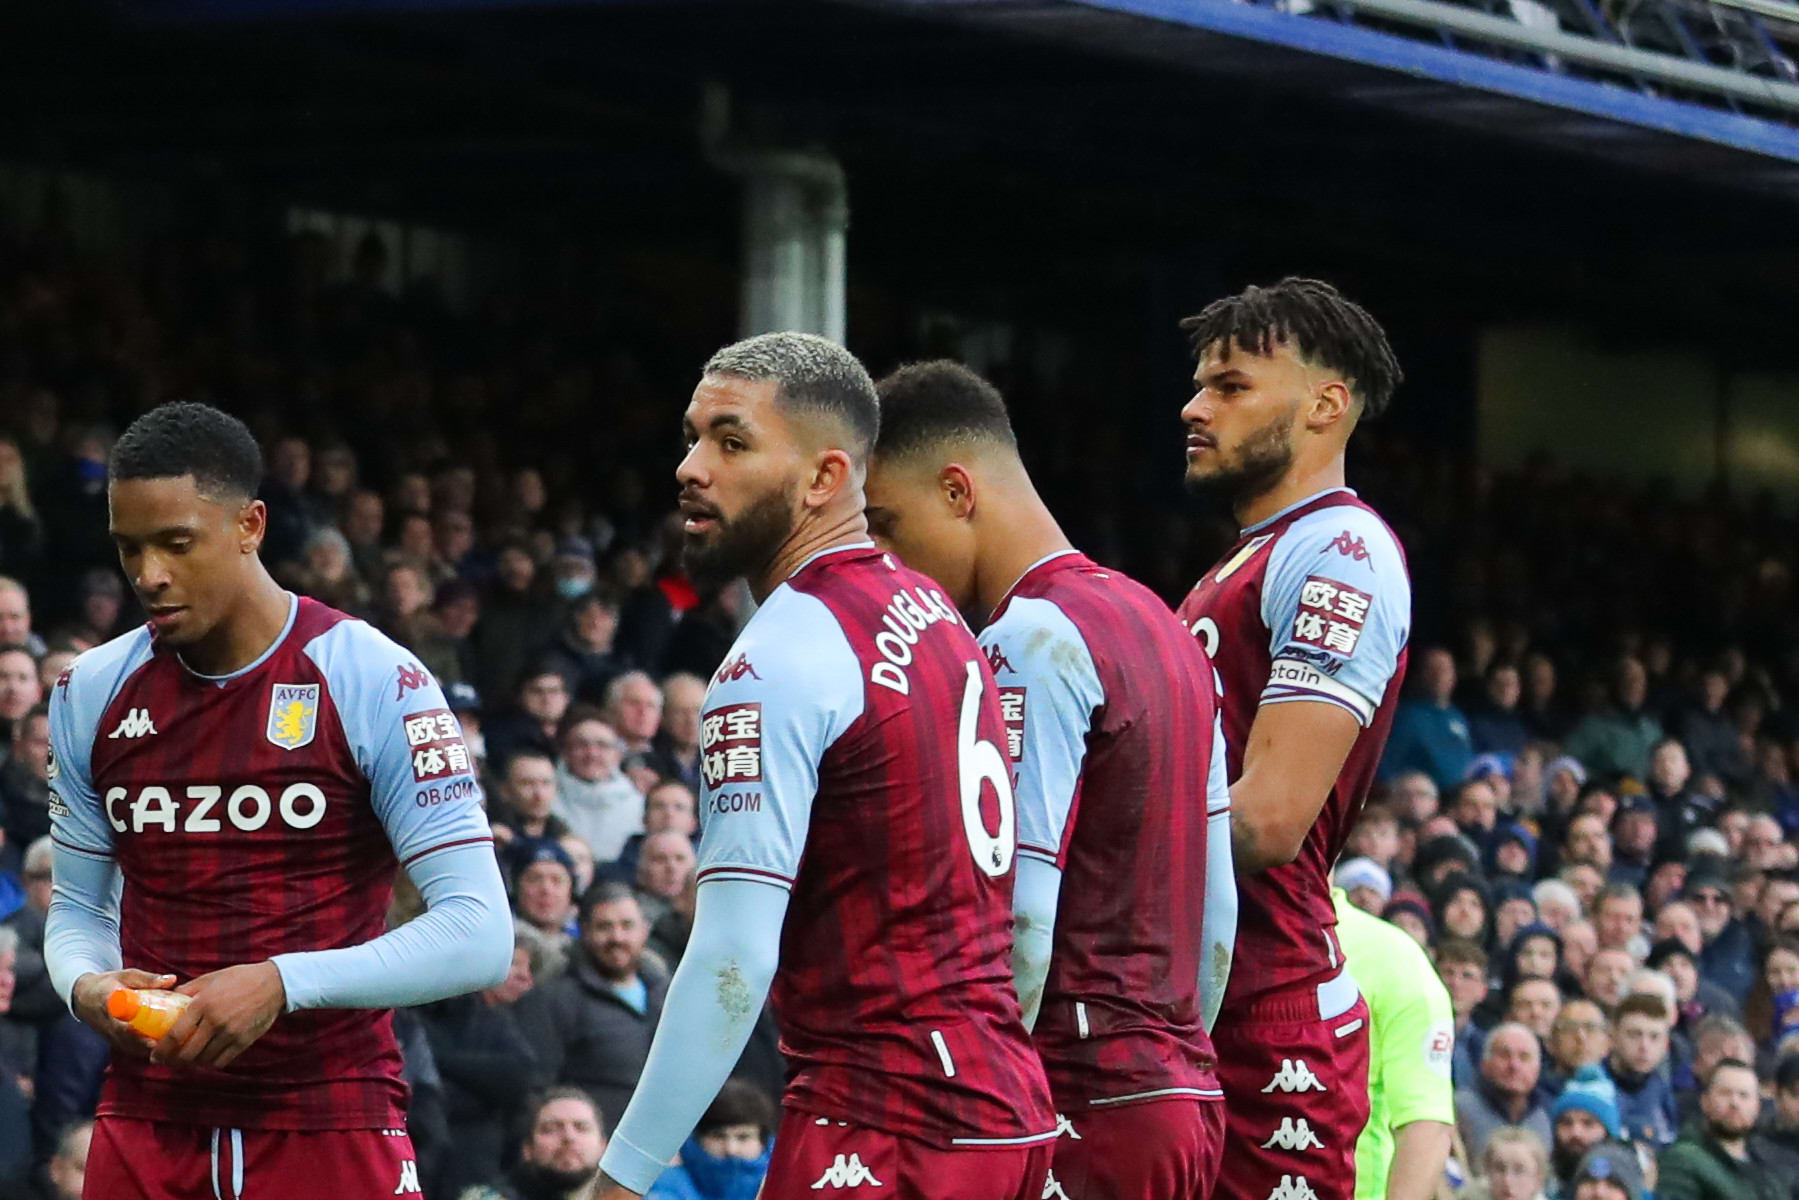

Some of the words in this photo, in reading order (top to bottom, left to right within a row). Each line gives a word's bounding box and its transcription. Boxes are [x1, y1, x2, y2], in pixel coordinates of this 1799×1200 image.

[1300, 580, 1370, 625] 欧宝
[871, 586, 958, 696] DOUGLAS
[1294, 610, 1361, 654] 体育
[277, 687, 317, 700] AVFC
[404, 712, 462, 747] 欧宝
[703, 708, 761, 750] 欧宝
[413, 742, 470, 778] 体育
[702, 744, 762, 785] 体育
[958, 659, 1017, 878] 6
[105, 782, 328, 833] CAZOO
[709, 792, 762, 815] .COM
